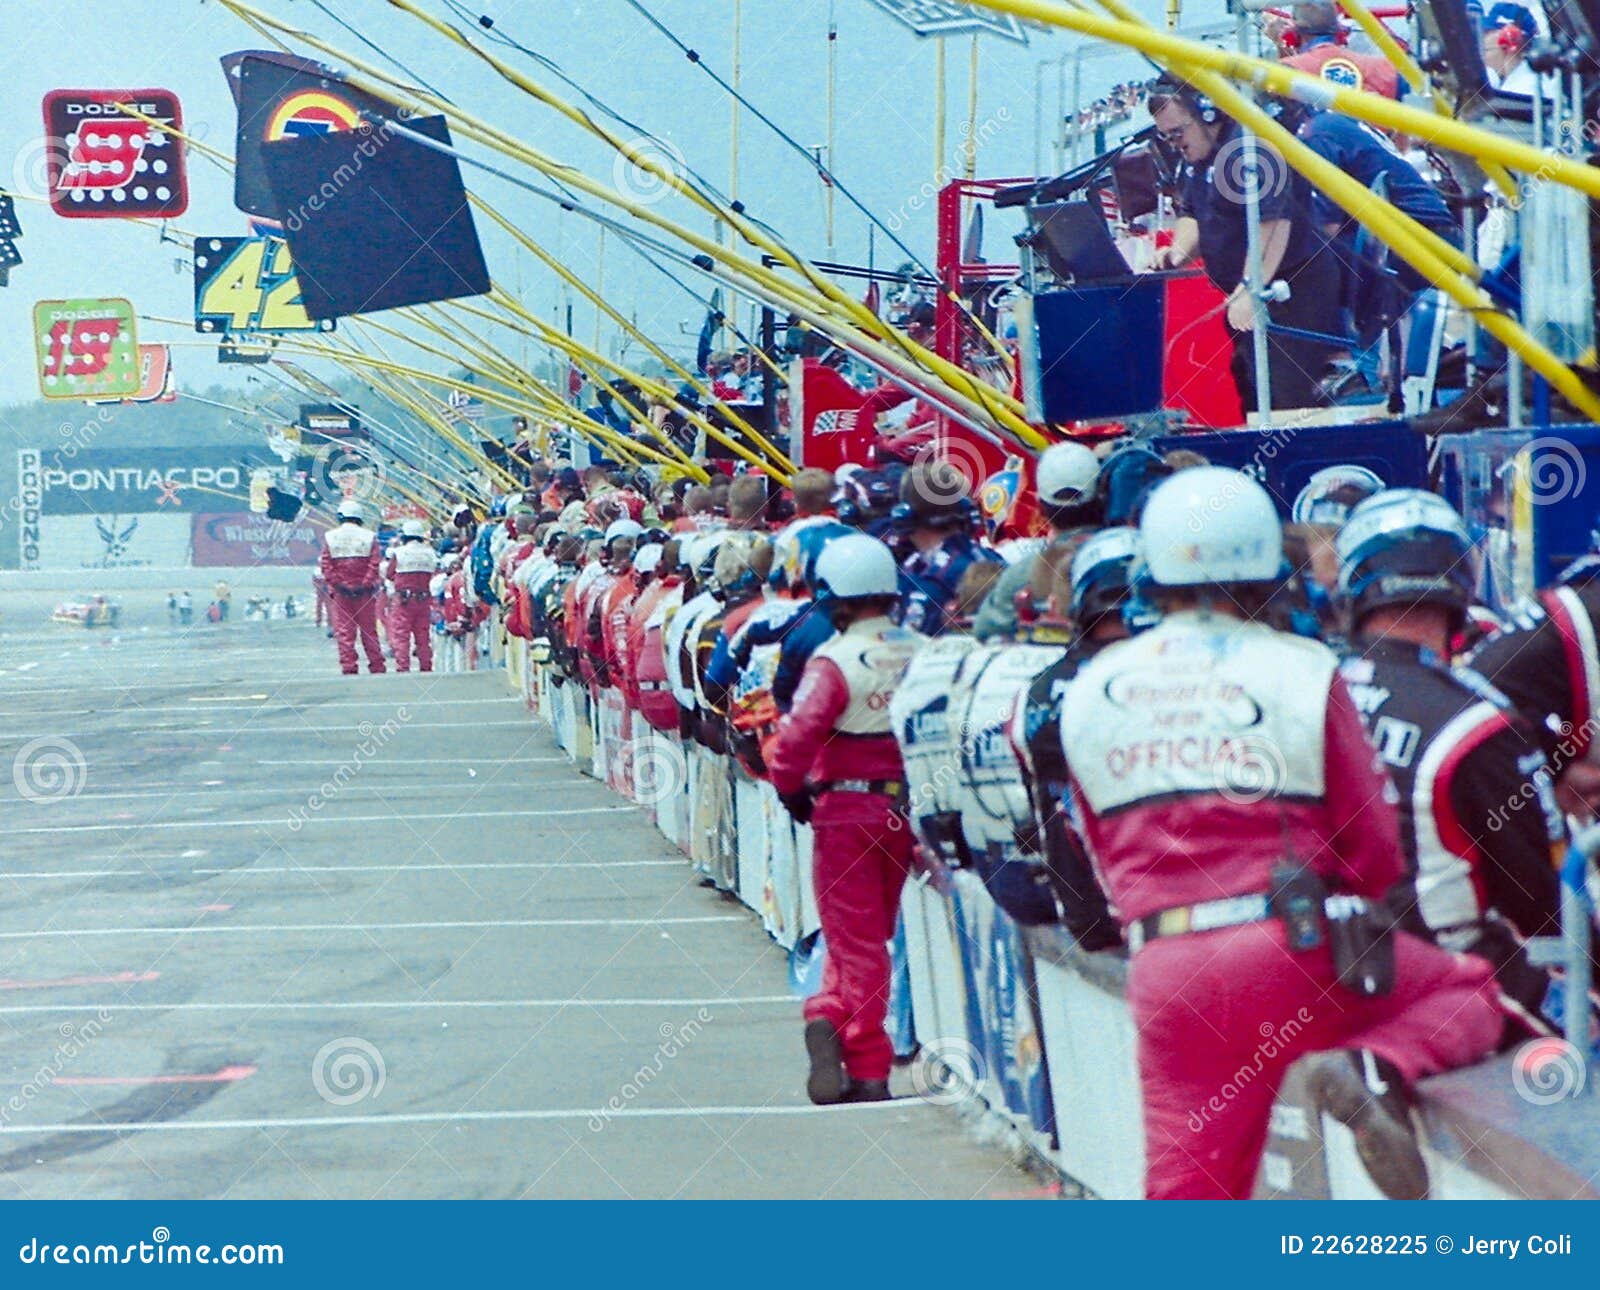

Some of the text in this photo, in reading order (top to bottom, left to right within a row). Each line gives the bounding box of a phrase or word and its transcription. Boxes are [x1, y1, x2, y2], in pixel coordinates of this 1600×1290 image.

[200, 240, 318, 330] 42
[22, 453, 40, 561] POCONO
[43, 467, 187, 490] PONTIAC
